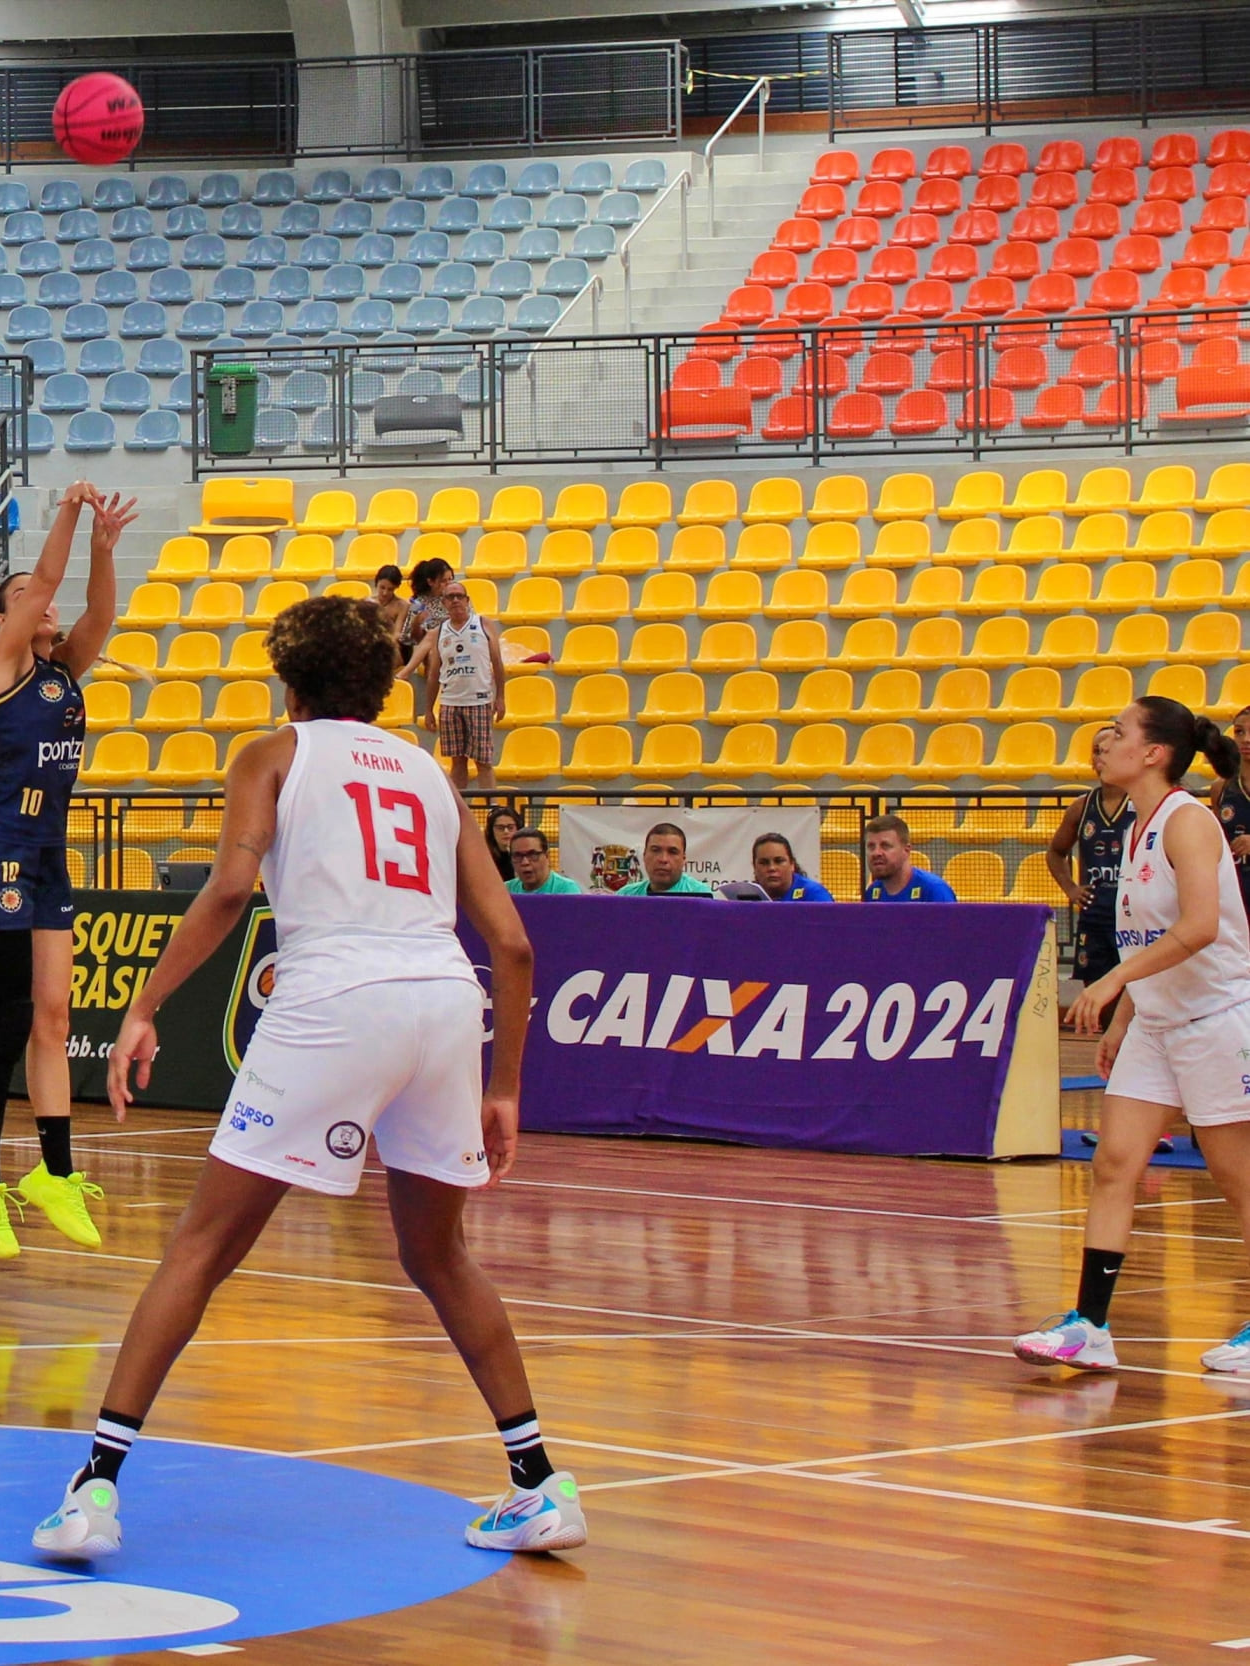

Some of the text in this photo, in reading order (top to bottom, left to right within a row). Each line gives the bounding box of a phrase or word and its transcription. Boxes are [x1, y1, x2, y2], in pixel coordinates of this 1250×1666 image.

[351, 750, 404, 773] KARINA
[20, 787, 43, 816] 10
[343, 781, 432, 895] 13
[1, 861, 20, 883] 10
[547, 969, 808, 1061] CAIXA
[811, 978, 1014, 1061] 2024
[234, 1101, 274, 1127] CURSO
